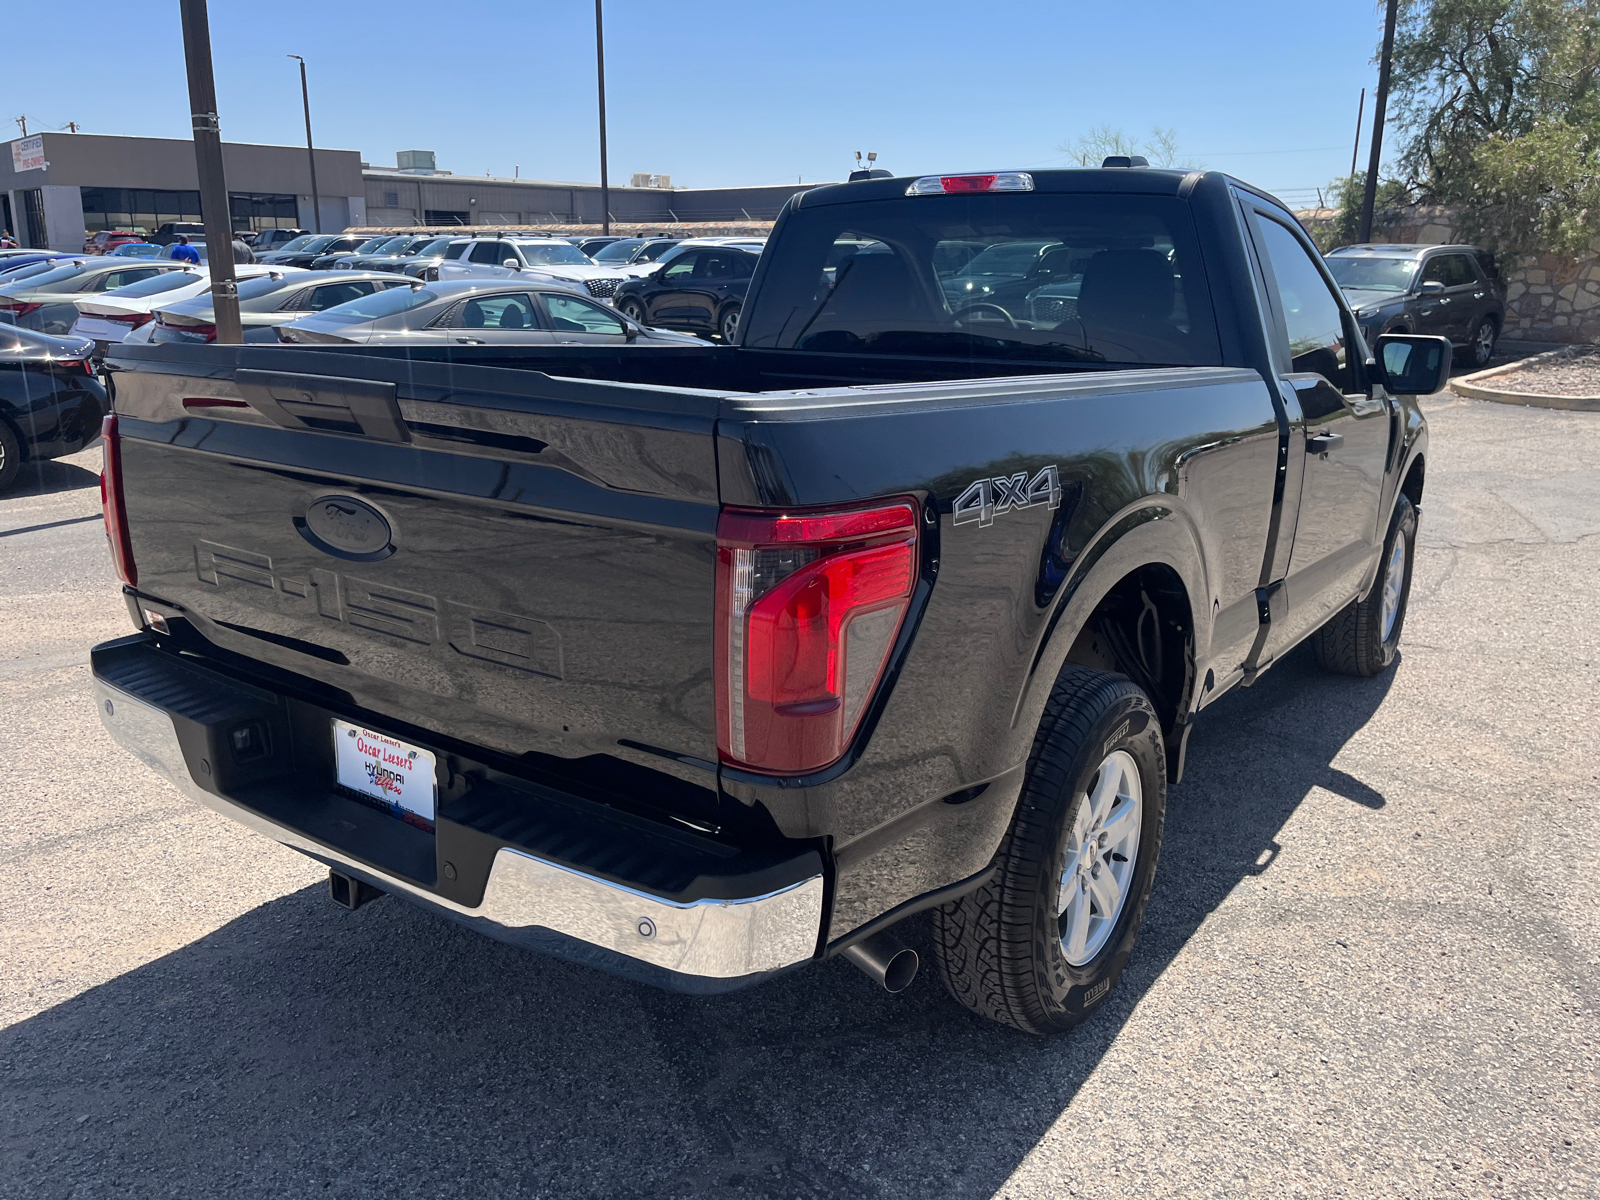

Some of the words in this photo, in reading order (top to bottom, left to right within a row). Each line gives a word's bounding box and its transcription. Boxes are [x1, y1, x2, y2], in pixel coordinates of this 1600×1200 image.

[21, 137, 42, 151] CERTIFIED
[193, 539, 564, 680] F-150
[362, 728, 379, 741] Oscar
[1103, 718, 1129, 756] PIRELLI
[357, 737, 381, 759] Oscar
[382, 747, 413, 771] Leeser's
[364, 761, 404, 785] HYUNDAI
[1083, 977, 1110, 1008] PIRELLI
